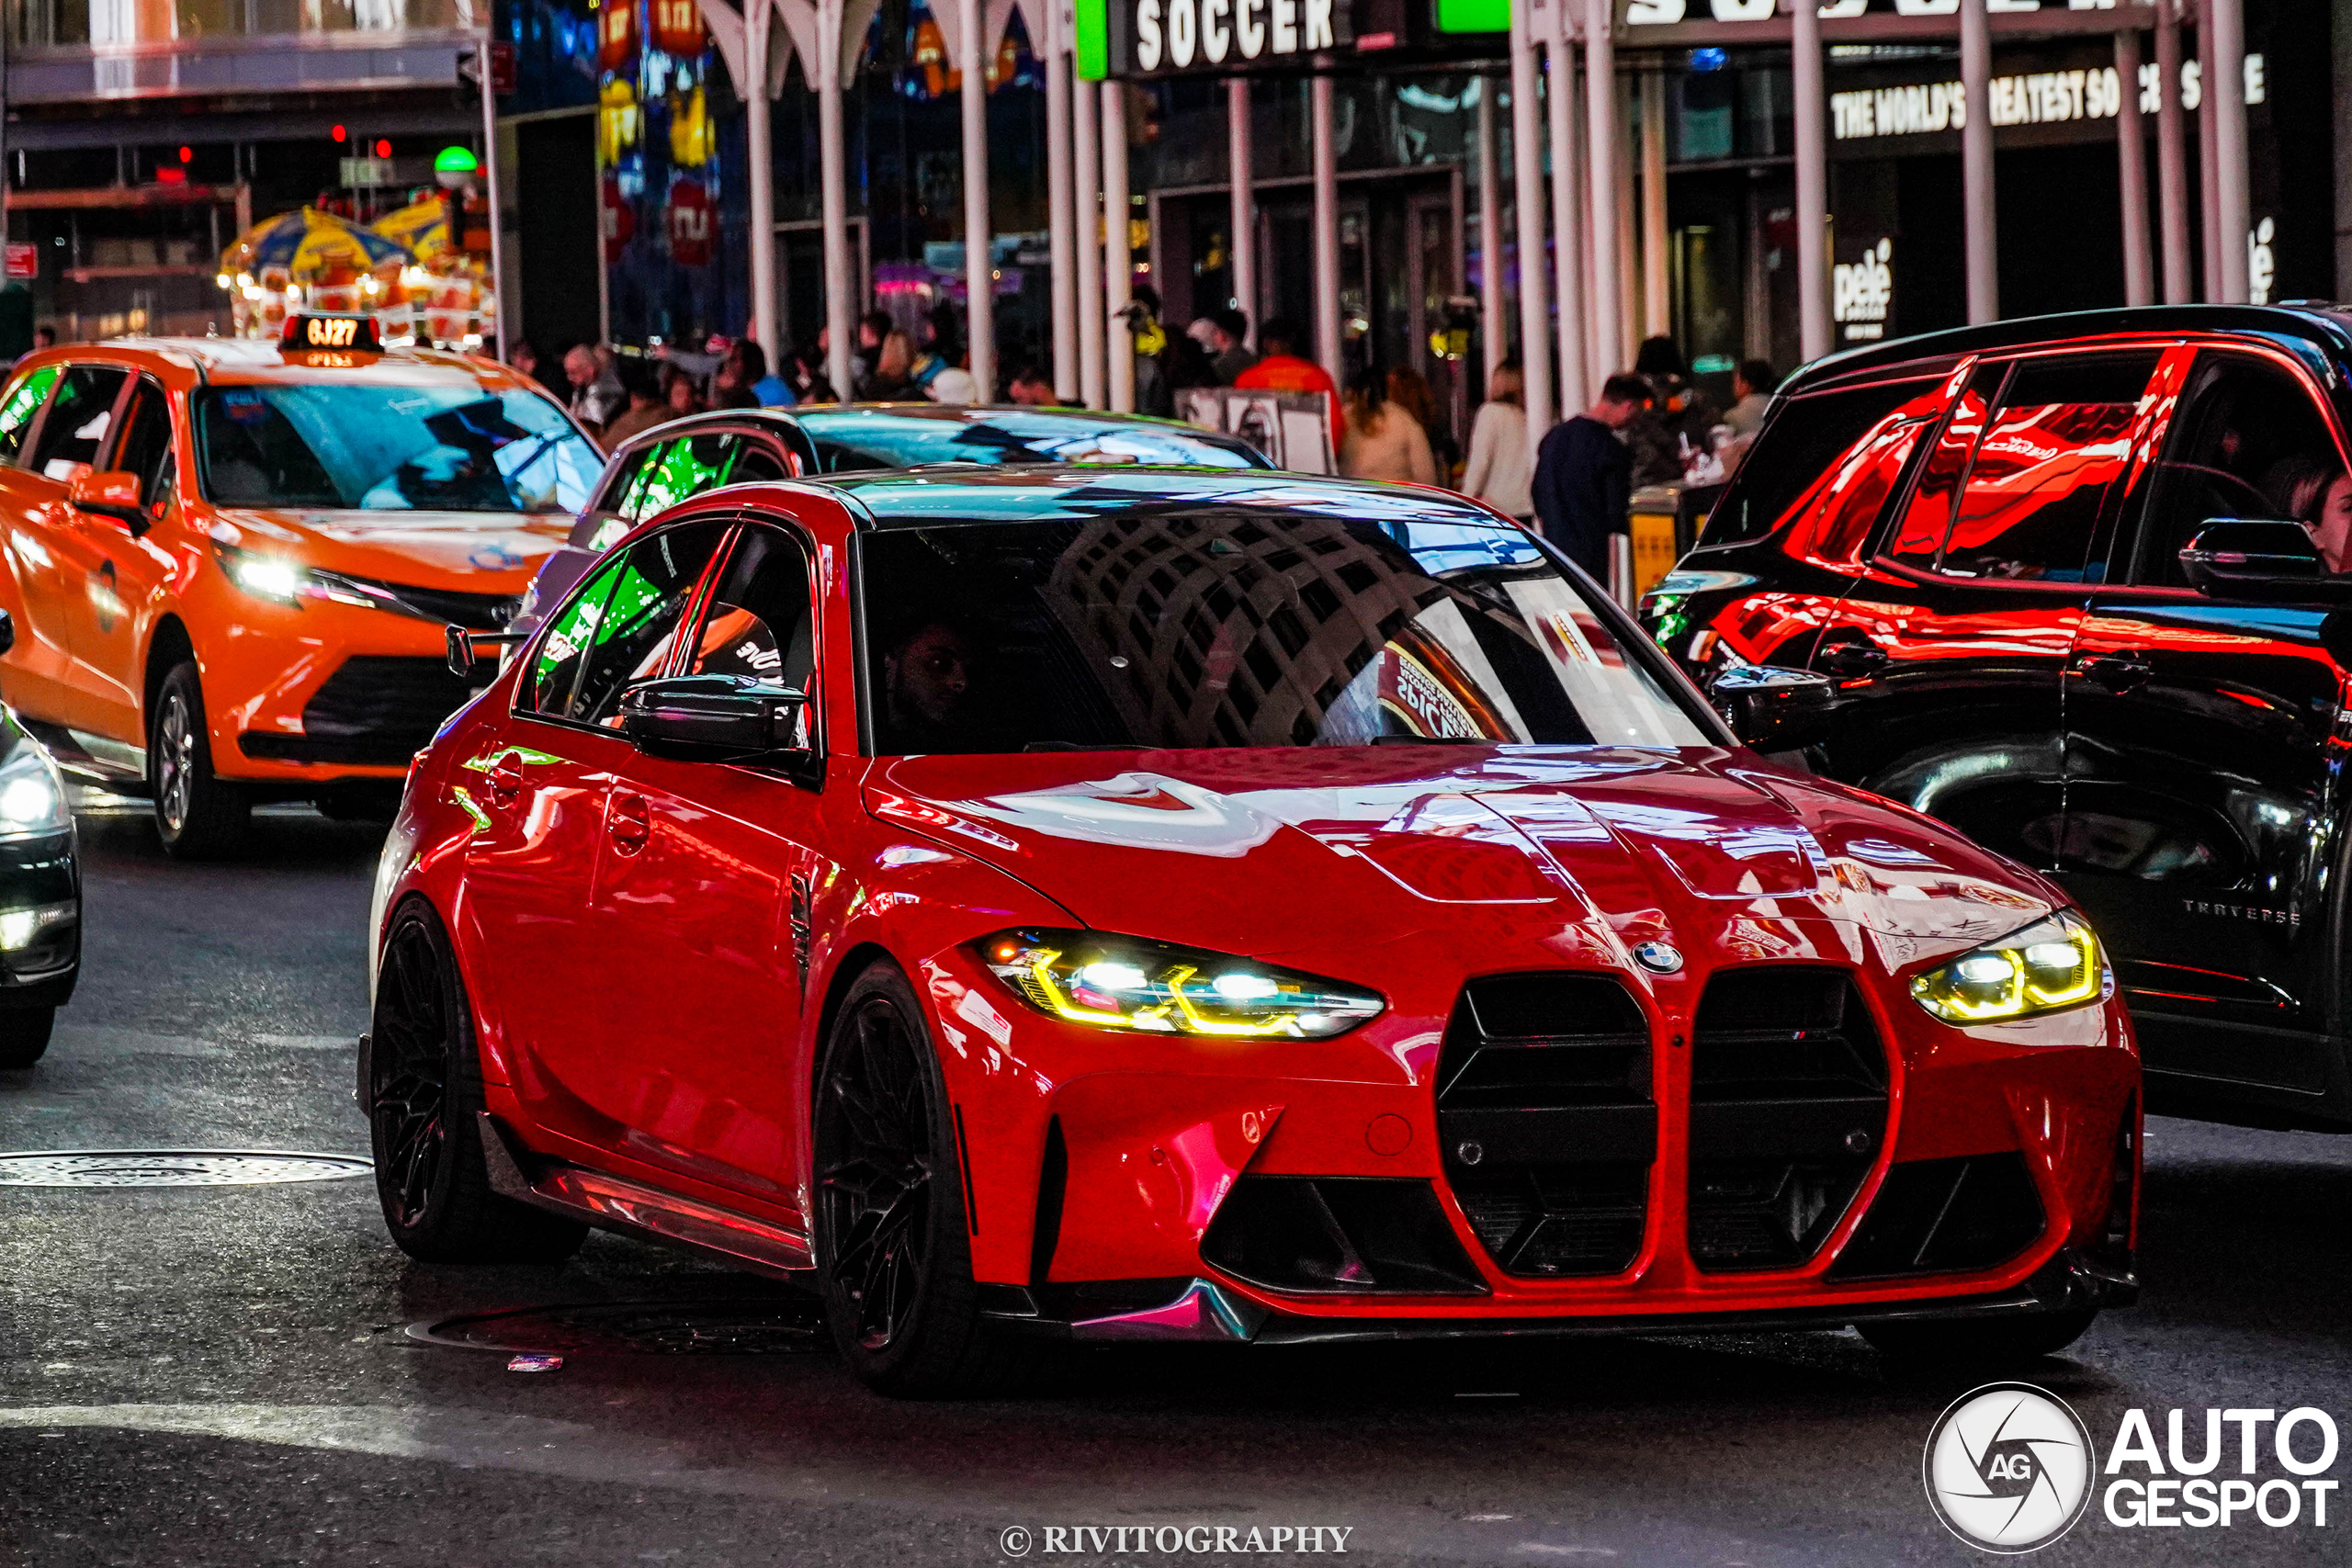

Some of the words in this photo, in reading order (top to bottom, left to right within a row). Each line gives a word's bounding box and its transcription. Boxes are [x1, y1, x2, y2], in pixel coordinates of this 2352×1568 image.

[1137, 0, 1333, 71] SOCCER
[1831, 90, 1875, 140] THE
[1875, 81, 1966, 136] WORLD'S
[307, 318, 357, 345] 6J27
[2182, 899, 2301, 926] TRAVERSE
